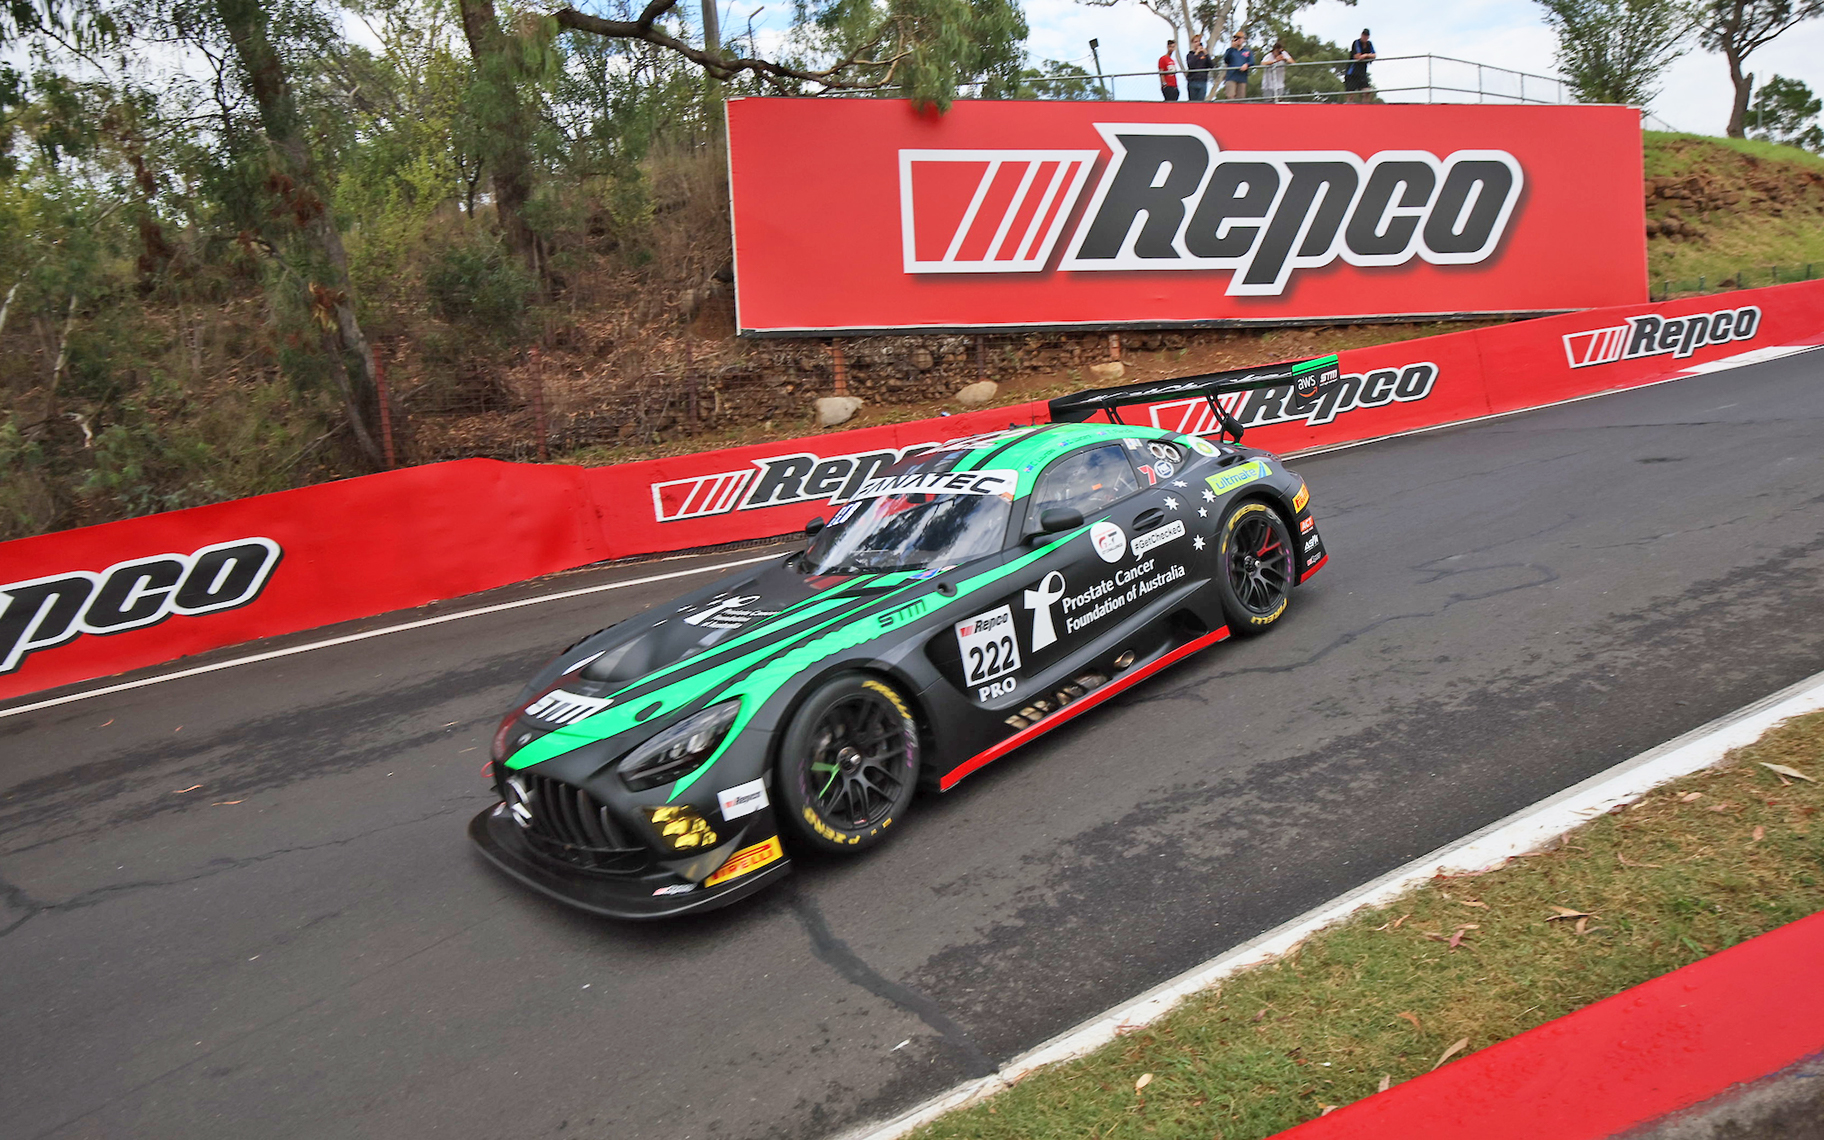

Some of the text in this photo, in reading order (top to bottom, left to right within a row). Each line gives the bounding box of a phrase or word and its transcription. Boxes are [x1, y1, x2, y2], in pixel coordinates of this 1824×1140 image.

[1060, 124, 1523, 295] Repco
[1622, 306, 1762, 359] Repco
[1297, 374, 1317, 390] aws
[739, 444, 932, 509] Rep
[853, 472, 1006, 498] FANATEC
[1215, 466, 1258, 490] ultimate
[1134, 524, 1182, 550] #GetChecked
[1062, 559, 1155, 614] Prostate Cancer
[1066, 564, 1186, 634] Foundation of Australia
[878, 599, 926, 627] STM
[974, 613, 1009, 633] Repco
[969, 635, 1015, 681] 222
[979, 676, 1017, 703] PRO
